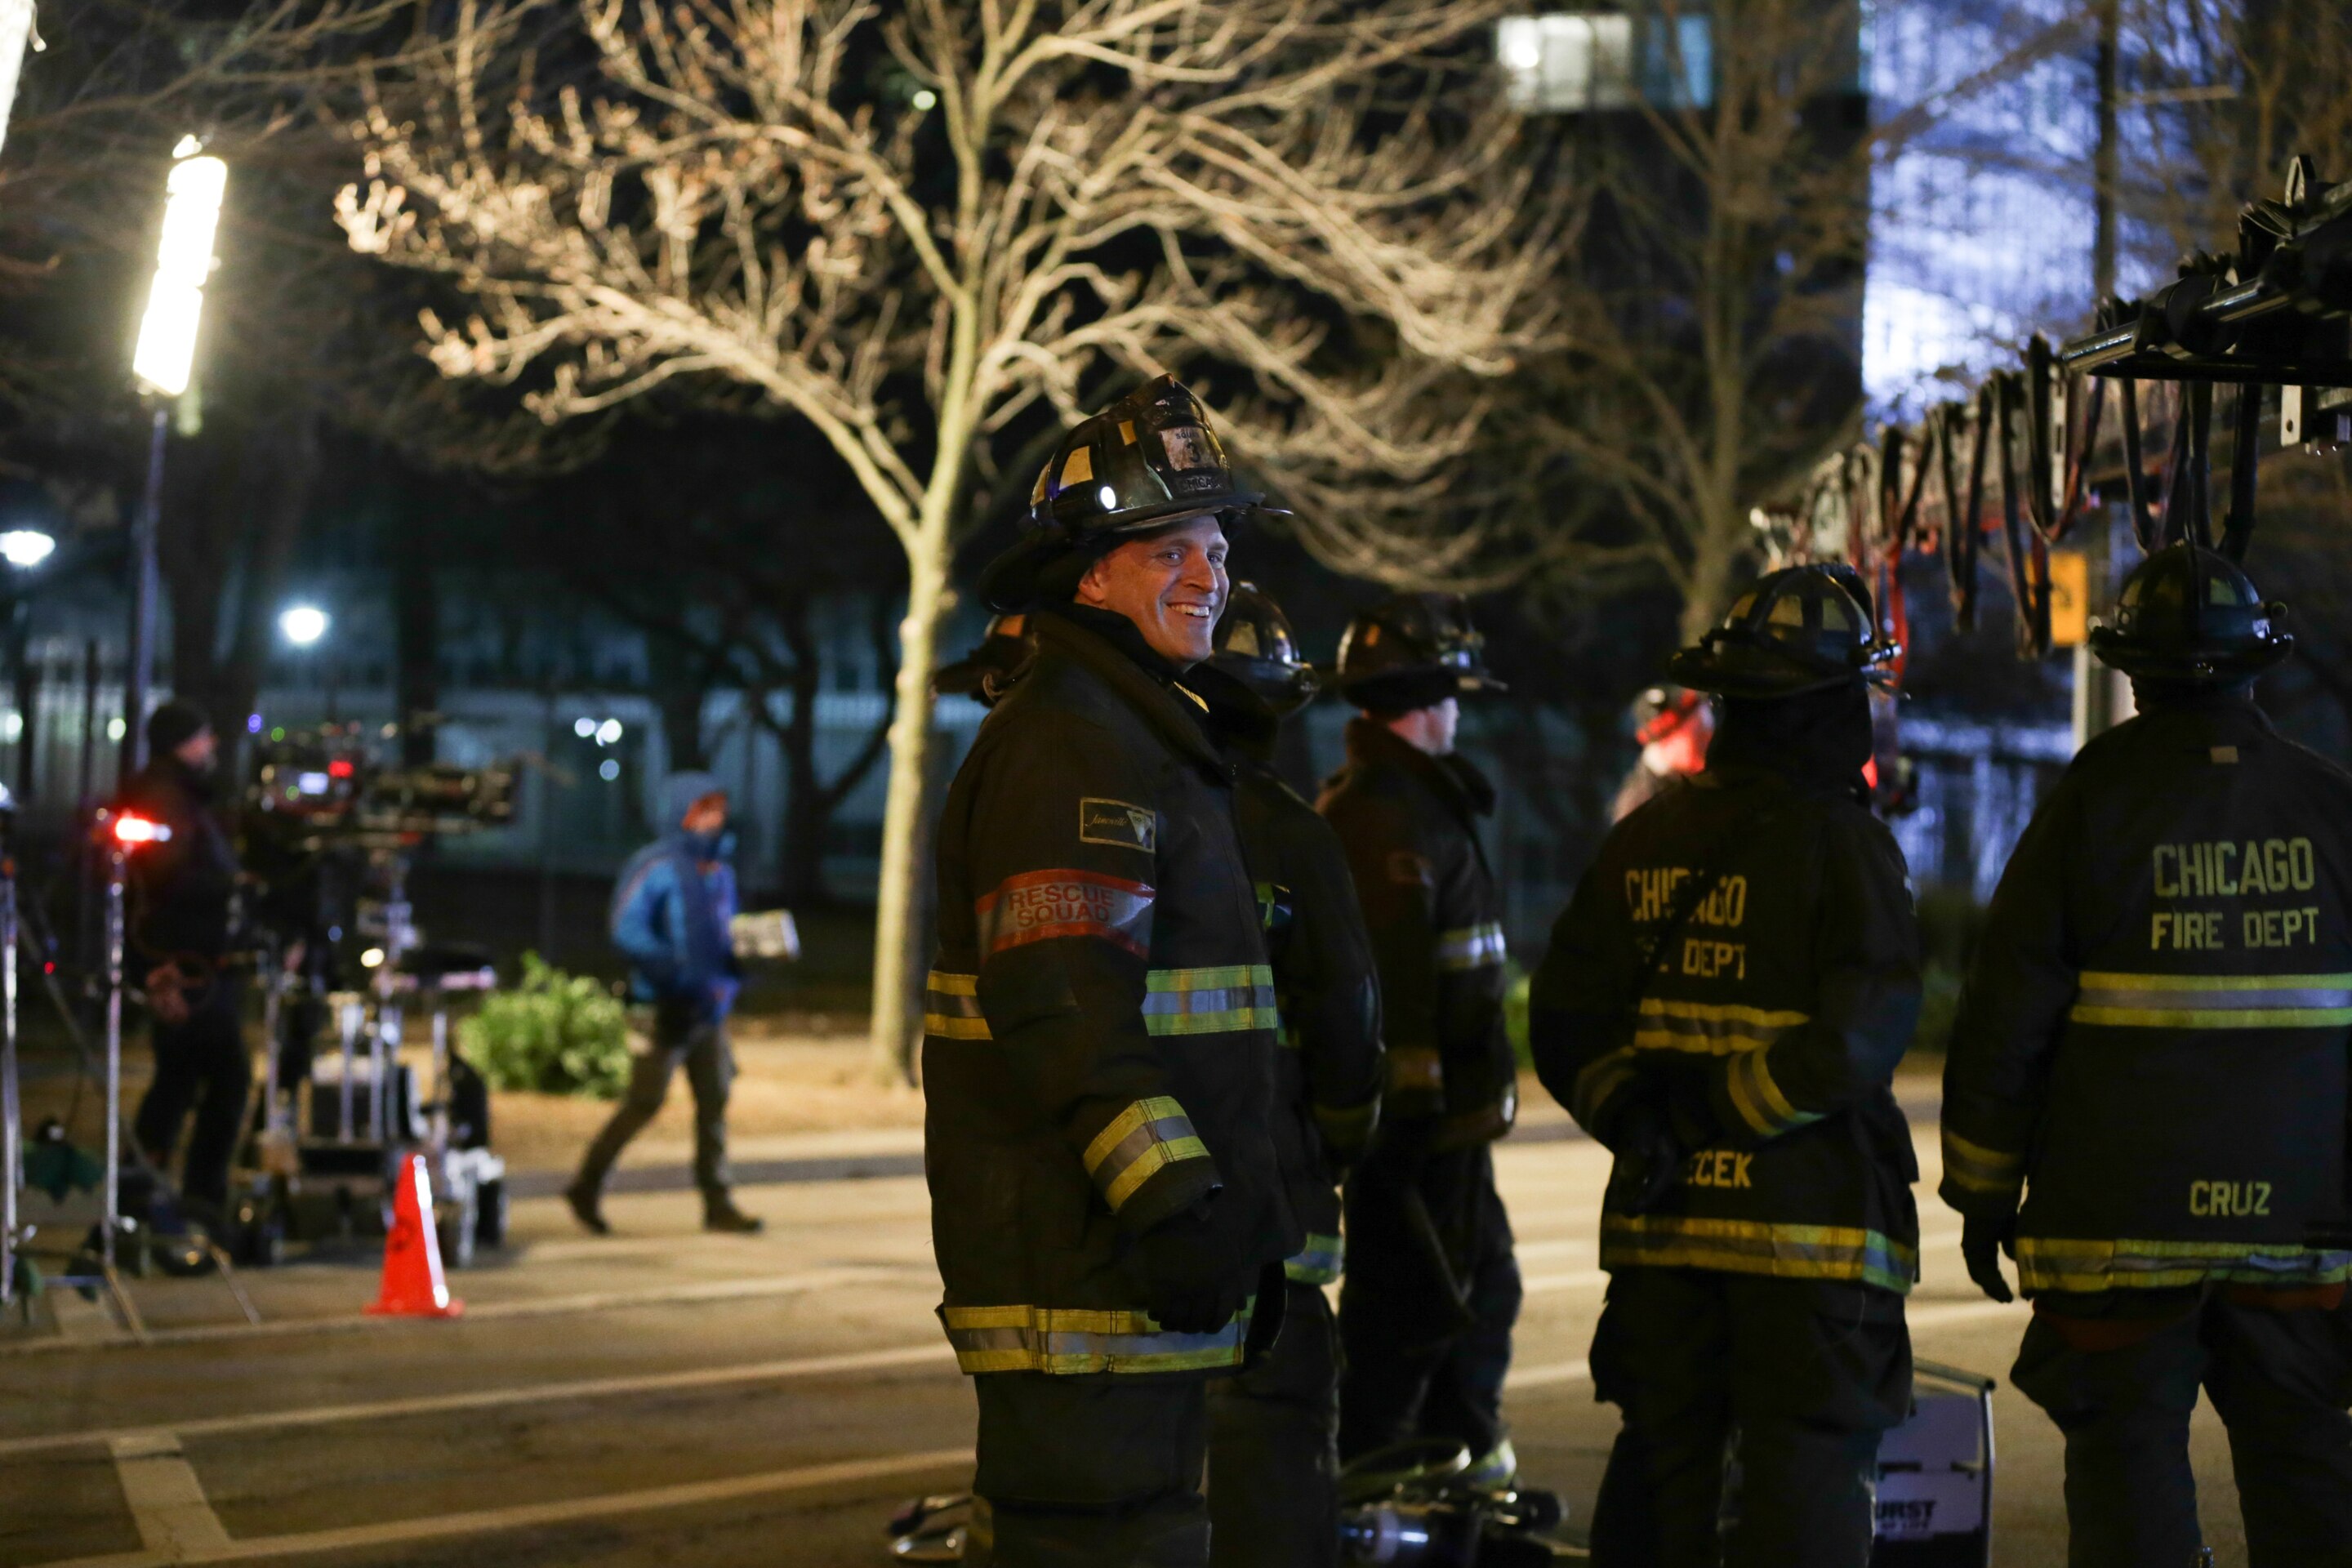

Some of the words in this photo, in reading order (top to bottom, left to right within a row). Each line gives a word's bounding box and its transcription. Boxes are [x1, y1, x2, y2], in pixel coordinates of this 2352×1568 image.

[2153, 836, 2315, 898] CHICAGO
[1009, 884, 1114, 911] RESCUE
[1018, 902, 1110, 927] SQUAD
[2150, 911, 2225, 951] FIRE
[2243, 906, 2319, 948] DEPT
[1682, 937, 1746, 981] DEPT
[2189, 1179, 2272, 1217] CRUZ
